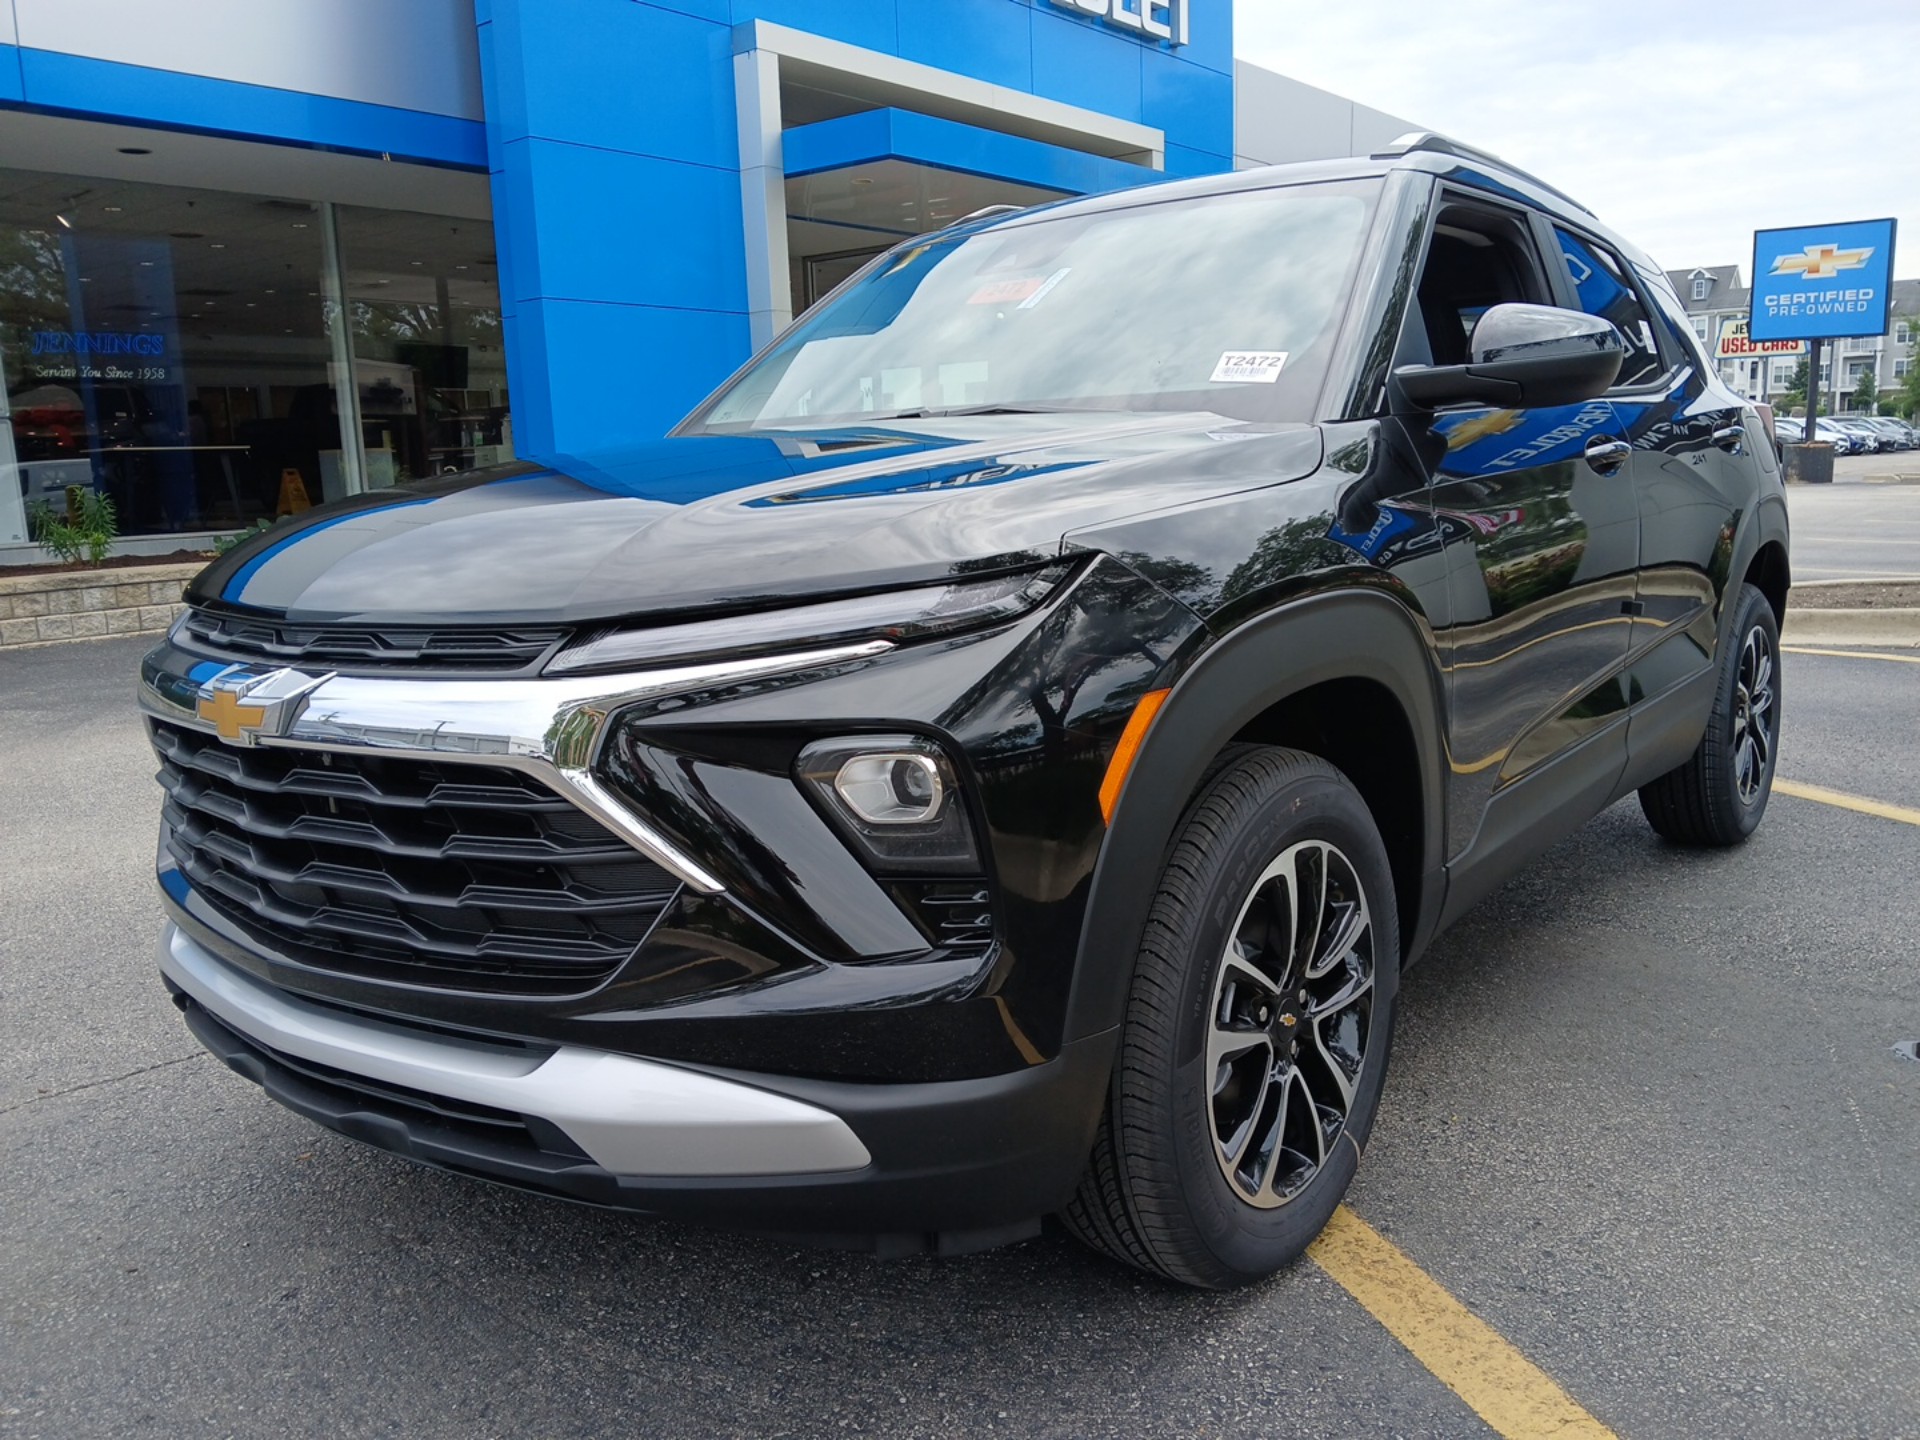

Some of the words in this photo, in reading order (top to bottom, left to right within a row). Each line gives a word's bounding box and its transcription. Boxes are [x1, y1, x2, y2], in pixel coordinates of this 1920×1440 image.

[1764, 288, 1874, 306] CERTIFIED
[1768, 301, 1868, 317] PRE-OWNED
[31, 331, 164, 355] JENNINGS
[1721, 337, 1757, 354] USED
[1224, 355, 1282, 368] T2472
[80, 366, 102, 378] You
[105, 365, 134, 379] Since
[137, 367, 165, 380] 1958
